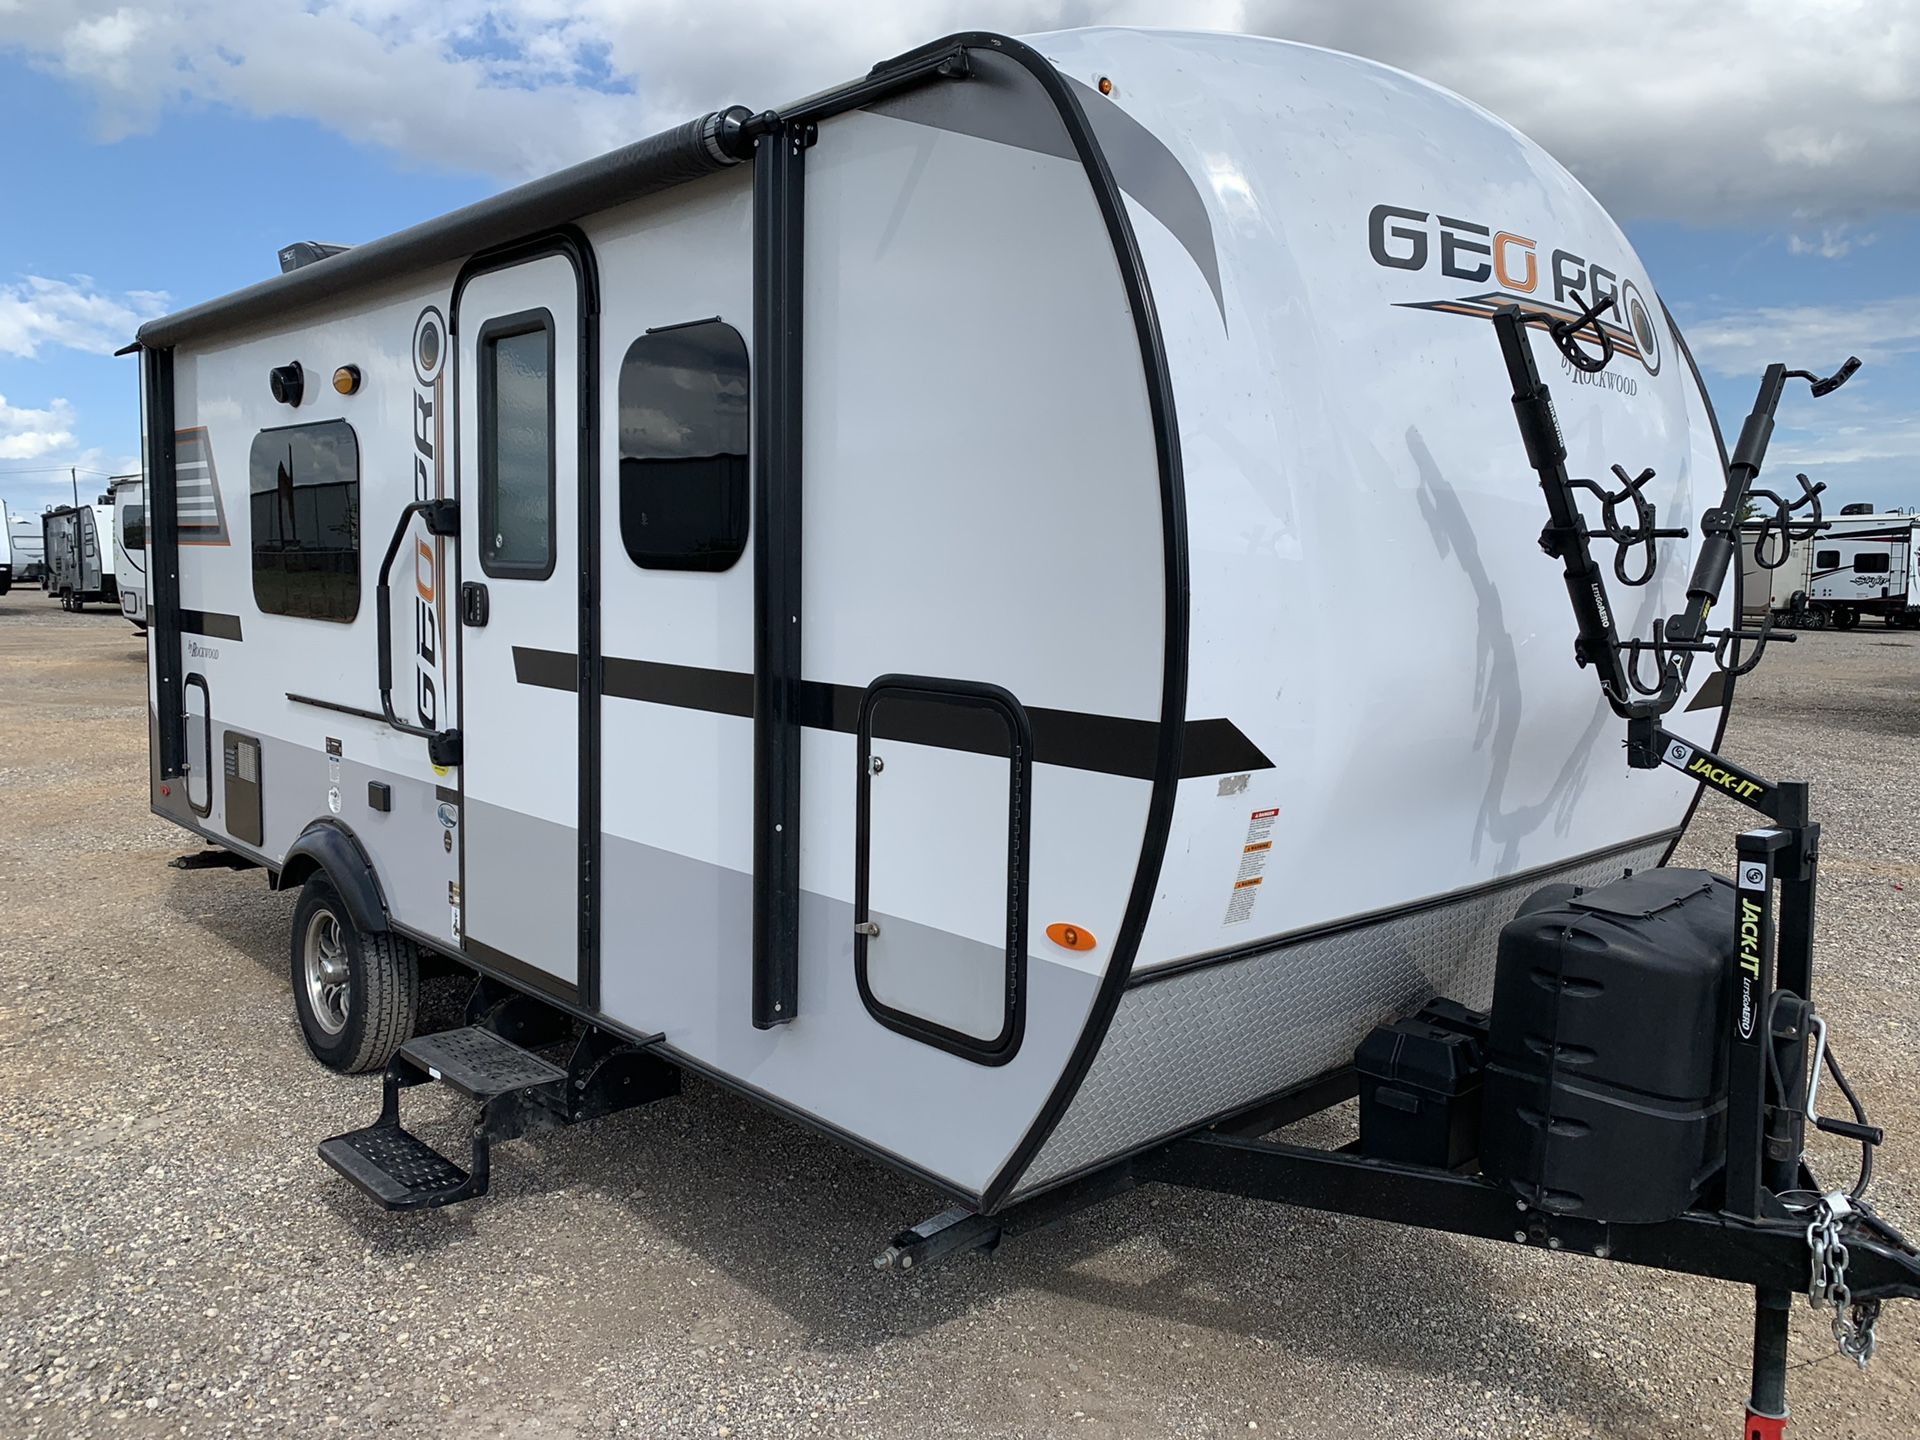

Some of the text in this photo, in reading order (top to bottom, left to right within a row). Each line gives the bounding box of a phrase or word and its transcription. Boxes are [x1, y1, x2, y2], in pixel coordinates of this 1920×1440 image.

[1368, 204, 1538, 293] GEO
[415, 530, 437, 731] GEO
[1688, 757, 1761, 798] JACK-IT
[1740, 897, 1762, 980] JACK-IT
